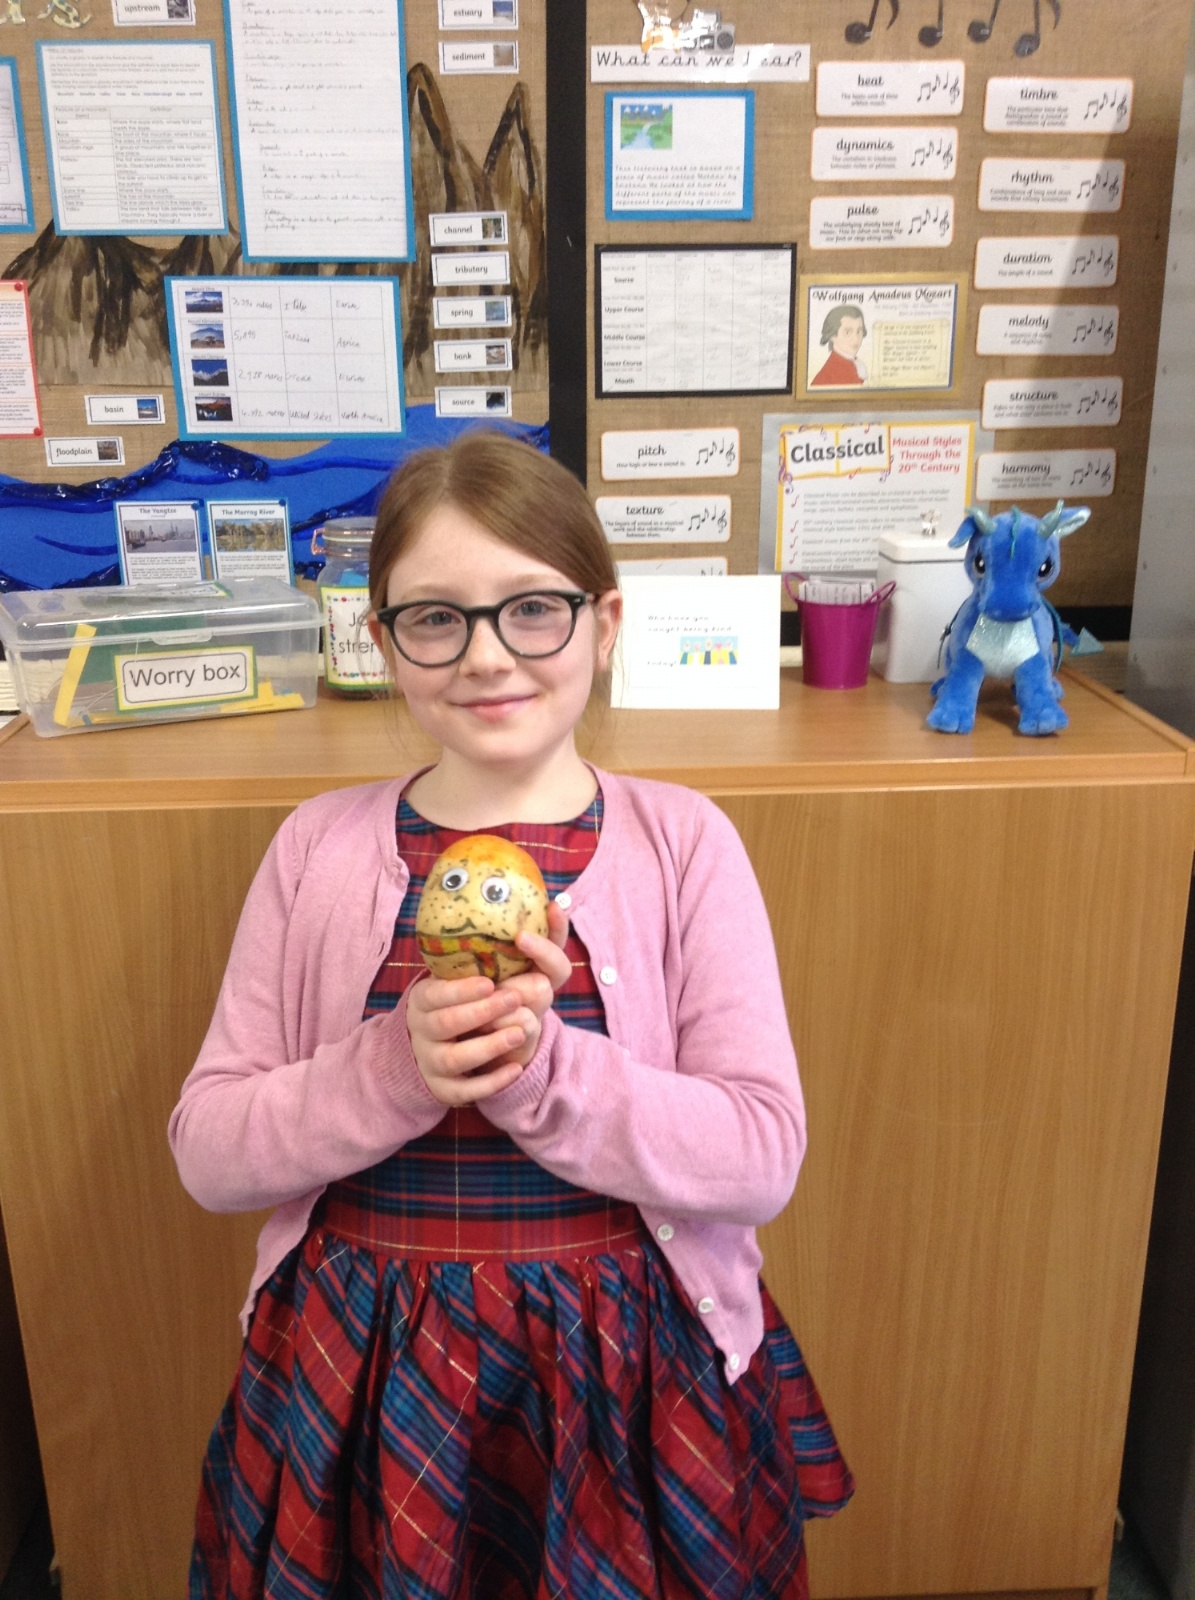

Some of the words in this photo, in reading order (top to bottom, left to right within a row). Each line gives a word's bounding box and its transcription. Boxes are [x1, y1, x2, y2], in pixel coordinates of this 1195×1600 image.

[124, 5, 160, 13] upstream
[454, 9, 482, 18] estuary
[597, 51, 650, 67] What
[658, 54, 699, 67] can
[706, 54, 735, 67] we
[858, 75, 884, 87] beat
[1020, 88, 1058, 100] timbre
[836, 138, 894, 155] dynamics
[1011, 170, 1054, 187] rhythm
[847, 203, 879, 219] pulse
[444, 226, 473, 234] channel
[1003, 252, 1052, 264] duration
[455, 265, 488, 274] tributary
[812, 290, 864, 303] Wolfgang
[869, 289, 912, 303] Amadeus
[915, 288, 952, 303] Mozart
[451, 309, 473, 317] spring
[1008, 315, 1049, 329] melody
[454, 352, 472, 360] bank
[1010, 391, 1059, 401] structure
[452, 398, 475, 406] source
[893, 437, 929, 447] Musical
[933, 437, 962, 447] Styles
[56, 448, 92, 457] floodplain
[637, 444, 667, 459] pitch
[790, 435, 884, 463] Classical
[900, 450, 941, 461] Through
[944, 450, 961, 459] the
[920, 463, 960, 474] Century
[1002, 462, 1051, 475] harmony
[626, 506, 664, 516] texture
[130, 668, 195, 688] Worry
[203, 664, 240, 681] box
